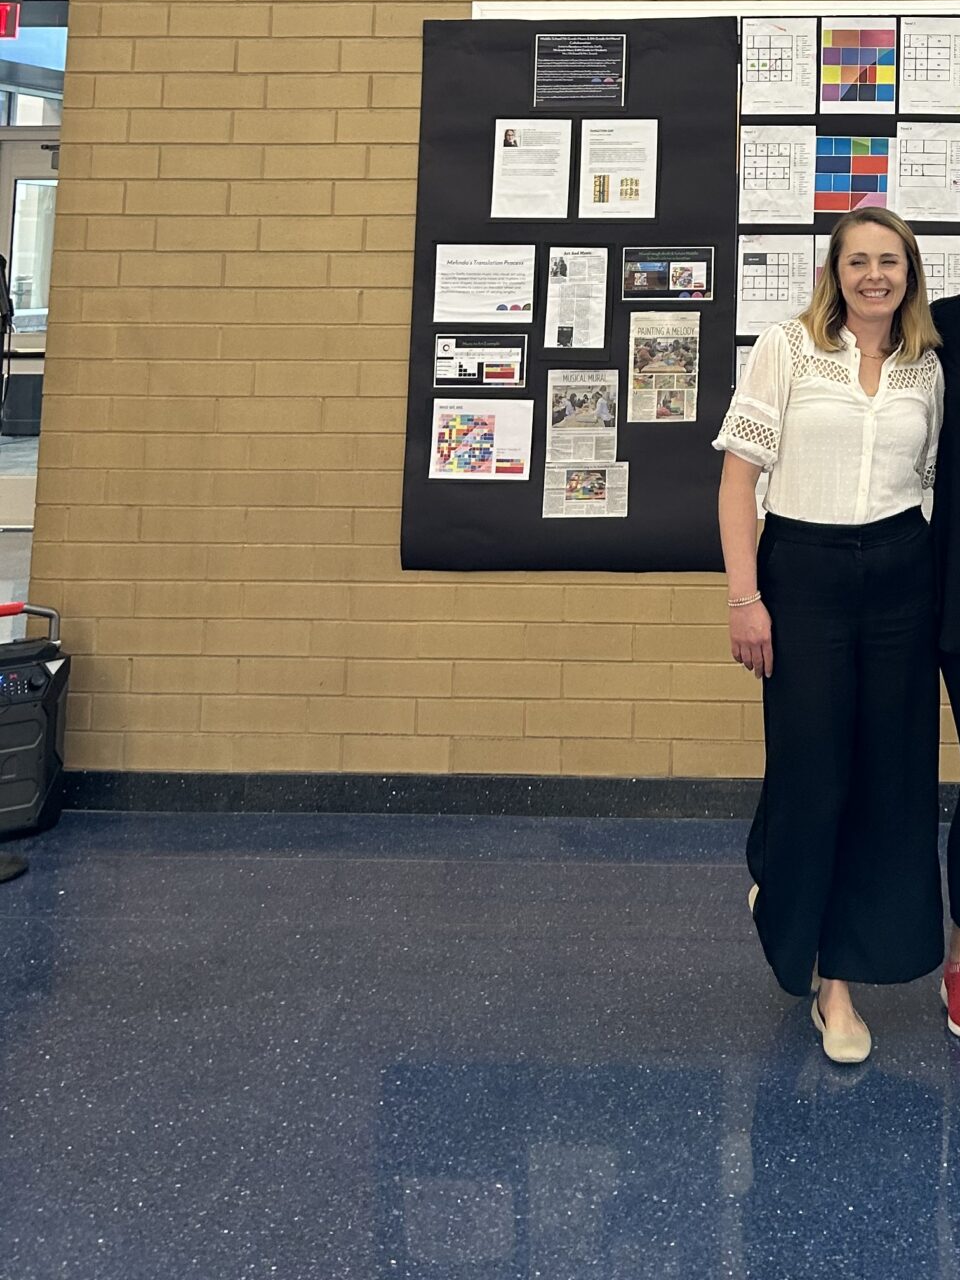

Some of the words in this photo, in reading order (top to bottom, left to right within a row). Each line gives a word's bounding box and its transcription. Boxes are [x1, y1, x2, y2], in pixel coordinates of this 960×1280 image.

[637, 327, 665, 336] PAINTING
[666, 327, 671, 336] A
[672, 327, 695, 336] MELODY
[562, 374, 586, 383] MUSICAL
[588, 374, 607, 383] MURAL
